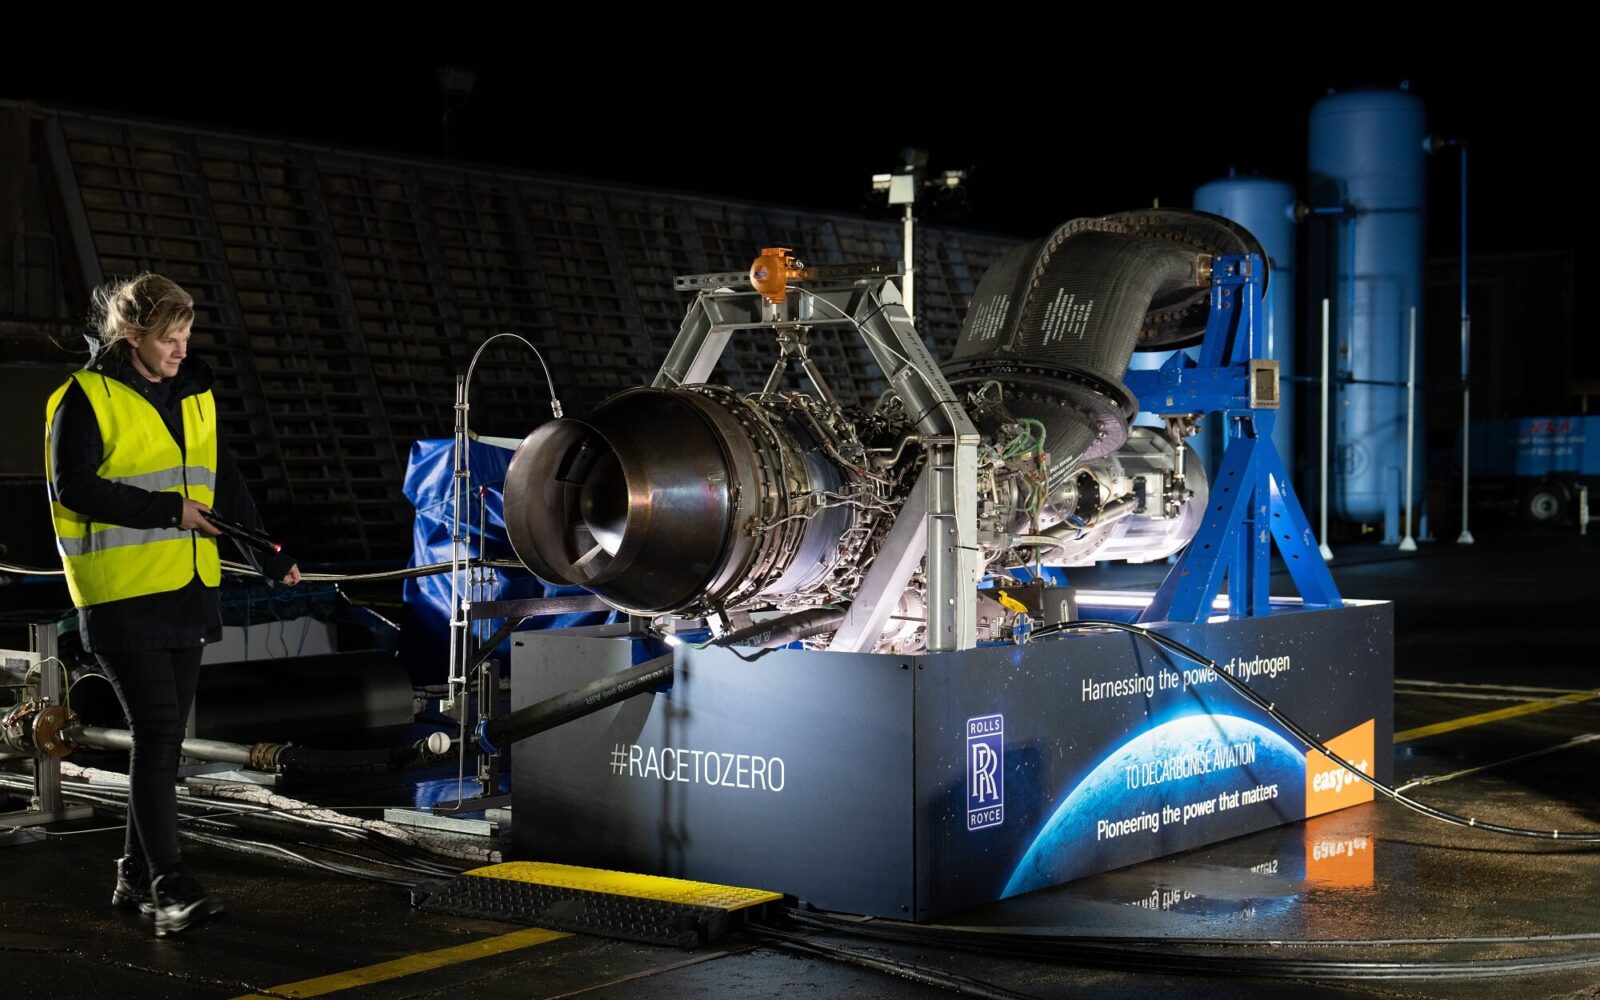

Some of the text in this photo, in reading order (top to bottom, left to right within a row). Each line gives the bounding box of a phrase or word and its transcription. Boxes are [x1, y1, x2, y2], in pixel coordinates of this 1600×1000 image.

[585, 692, 601, 705] AIR
[1082, 655, 1290, 702] Harnessing the power of hydrogen
[970, 719, 1000, 734] ROLLS
[609, 743, 785, 792] #RACETOZERO
[971, 742, 999, 803] RR
[1125, 742, 1256, 790] TO DECARBONISE AVIATION
[970, 809, 1001, 826] ROYCE
[1097, 783, 1279, 841] Pioneering the power that matters
